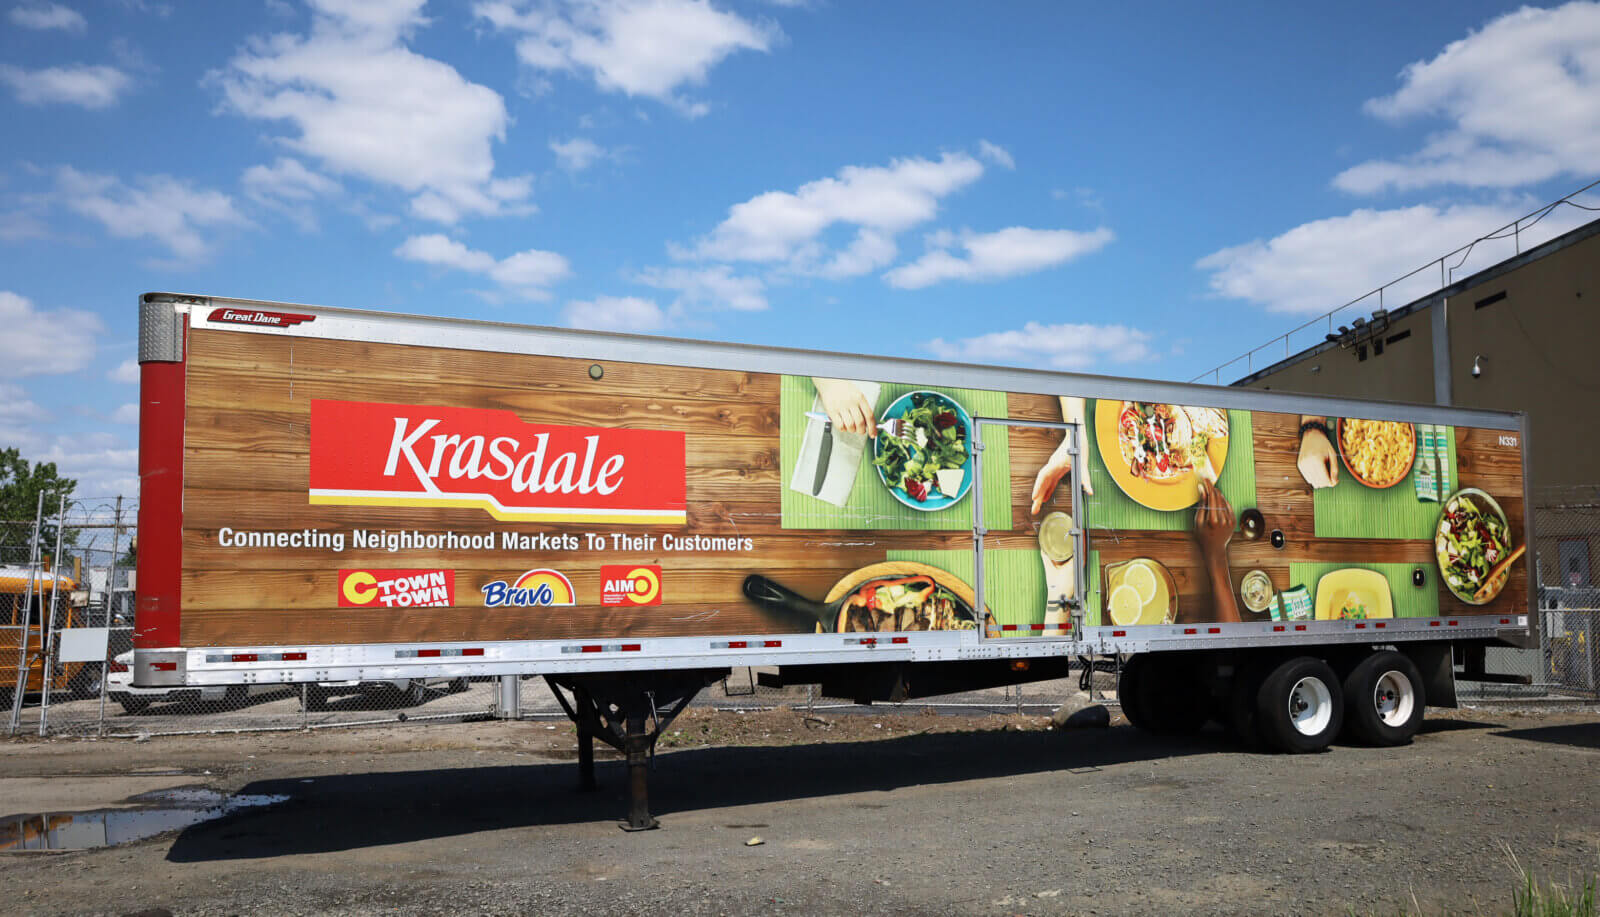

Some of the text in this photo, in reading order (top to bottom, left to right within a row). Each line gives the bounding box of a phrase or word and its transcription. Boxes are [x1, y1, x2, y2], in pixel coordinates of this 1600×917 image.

[222, 309, 281, 324] Great Dane
[1498, 434, 1517, 447] N331
[383, 417, 625, 496] Krasdale
[218, 527, 754, 553] Connecting Neighborhood Markets To Their Customers
[379, 585, 449, 607] TOWN
[481, 580, 555, 608] Bravo
